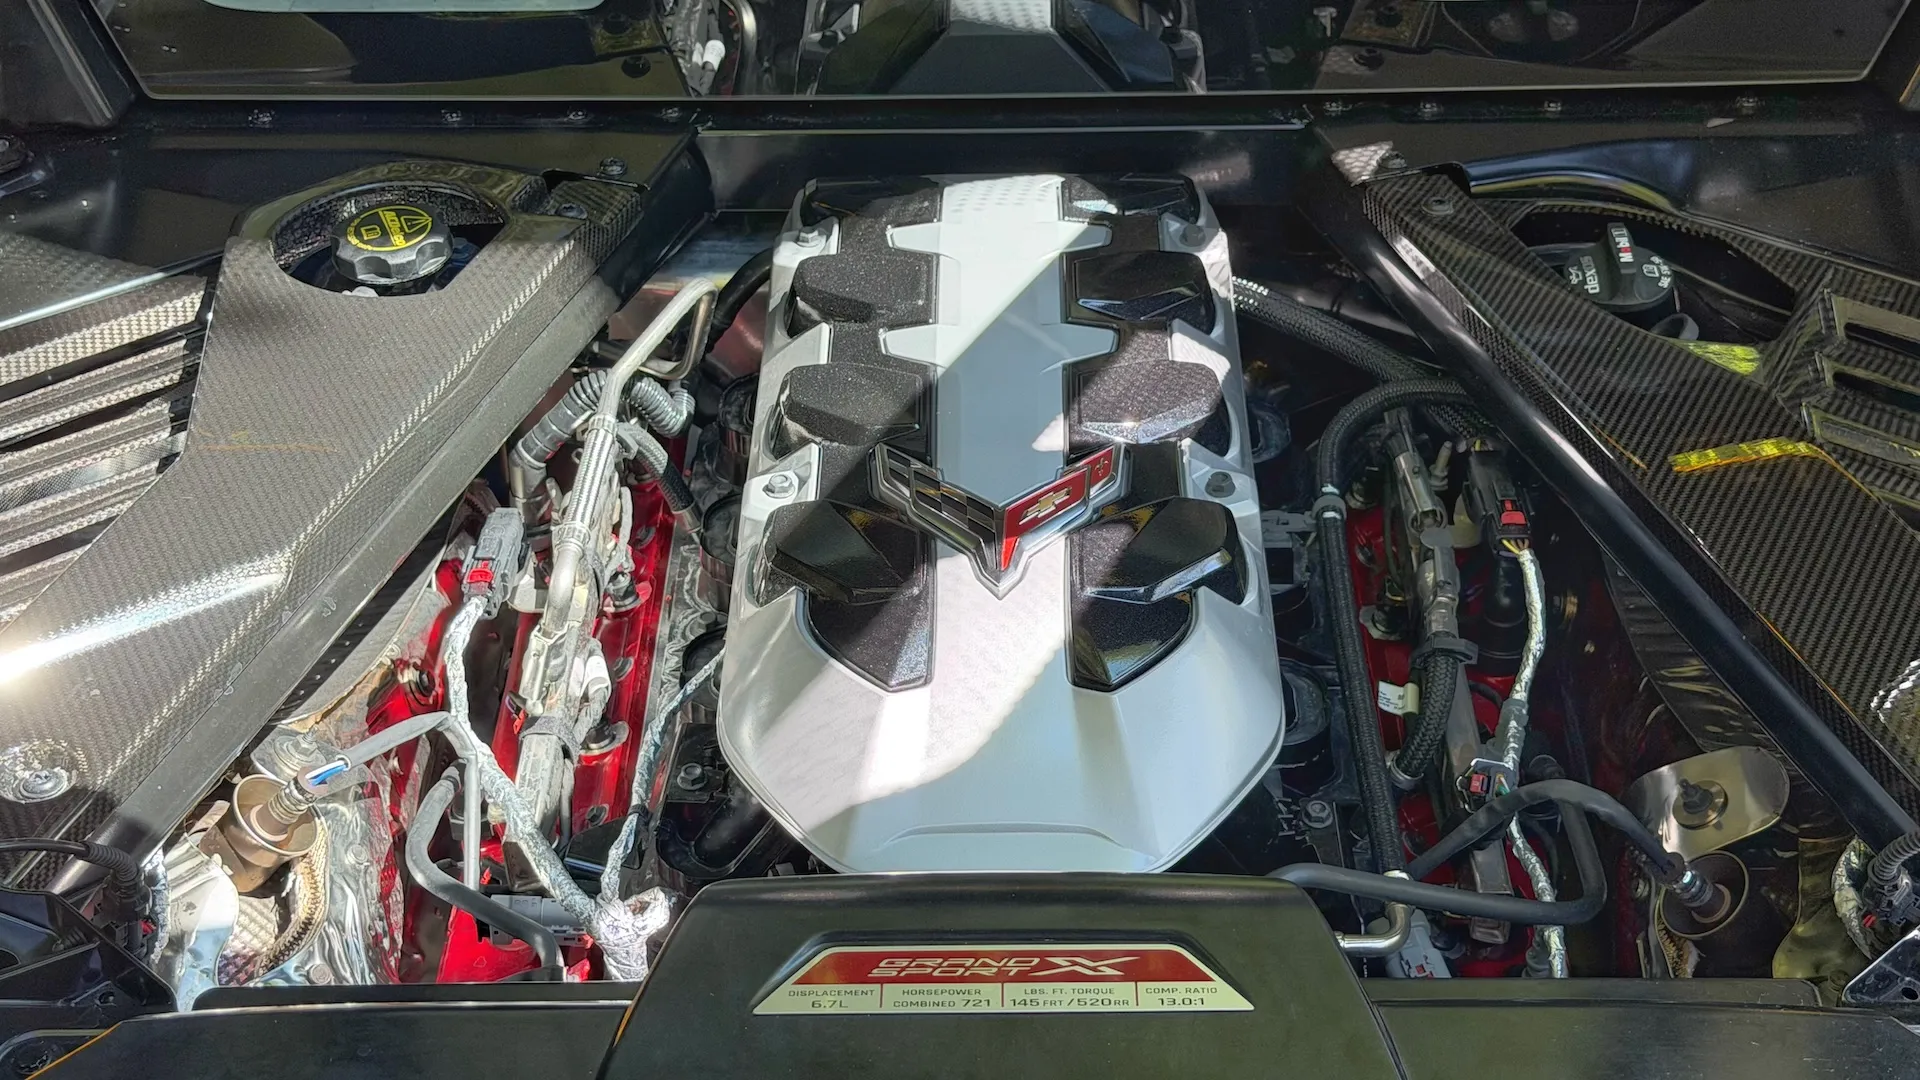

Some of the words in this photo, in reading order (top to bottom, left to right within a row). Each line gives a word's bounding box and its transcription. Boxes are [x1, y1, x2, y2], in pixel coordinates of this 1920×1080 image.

[383, 211, 407, 246] ACDelco
[1614, 237, 1635, 263] Mobil
[1580, 255, 1600, 294] dexos
[878, 957, 1042, 968] GRAND
[867, 966, 1032, 977] SPORT
[788, 989, 876, 997] DISPLACEMENT
[902, 988, 982, 996] HORSEPOWER
[1024, 987, 1049, 995] LBS.
[1052, 987, 1067, 995] FT.
[1071, 987, 1115, 995] TORQUE
[811, 999, 849, 1009] 6.7L
[893, 1000, 956, 1008] COMBINED
[961, 998, 991, 1007] 721
[1157, 997, 1205, 1006] 13.0:1
